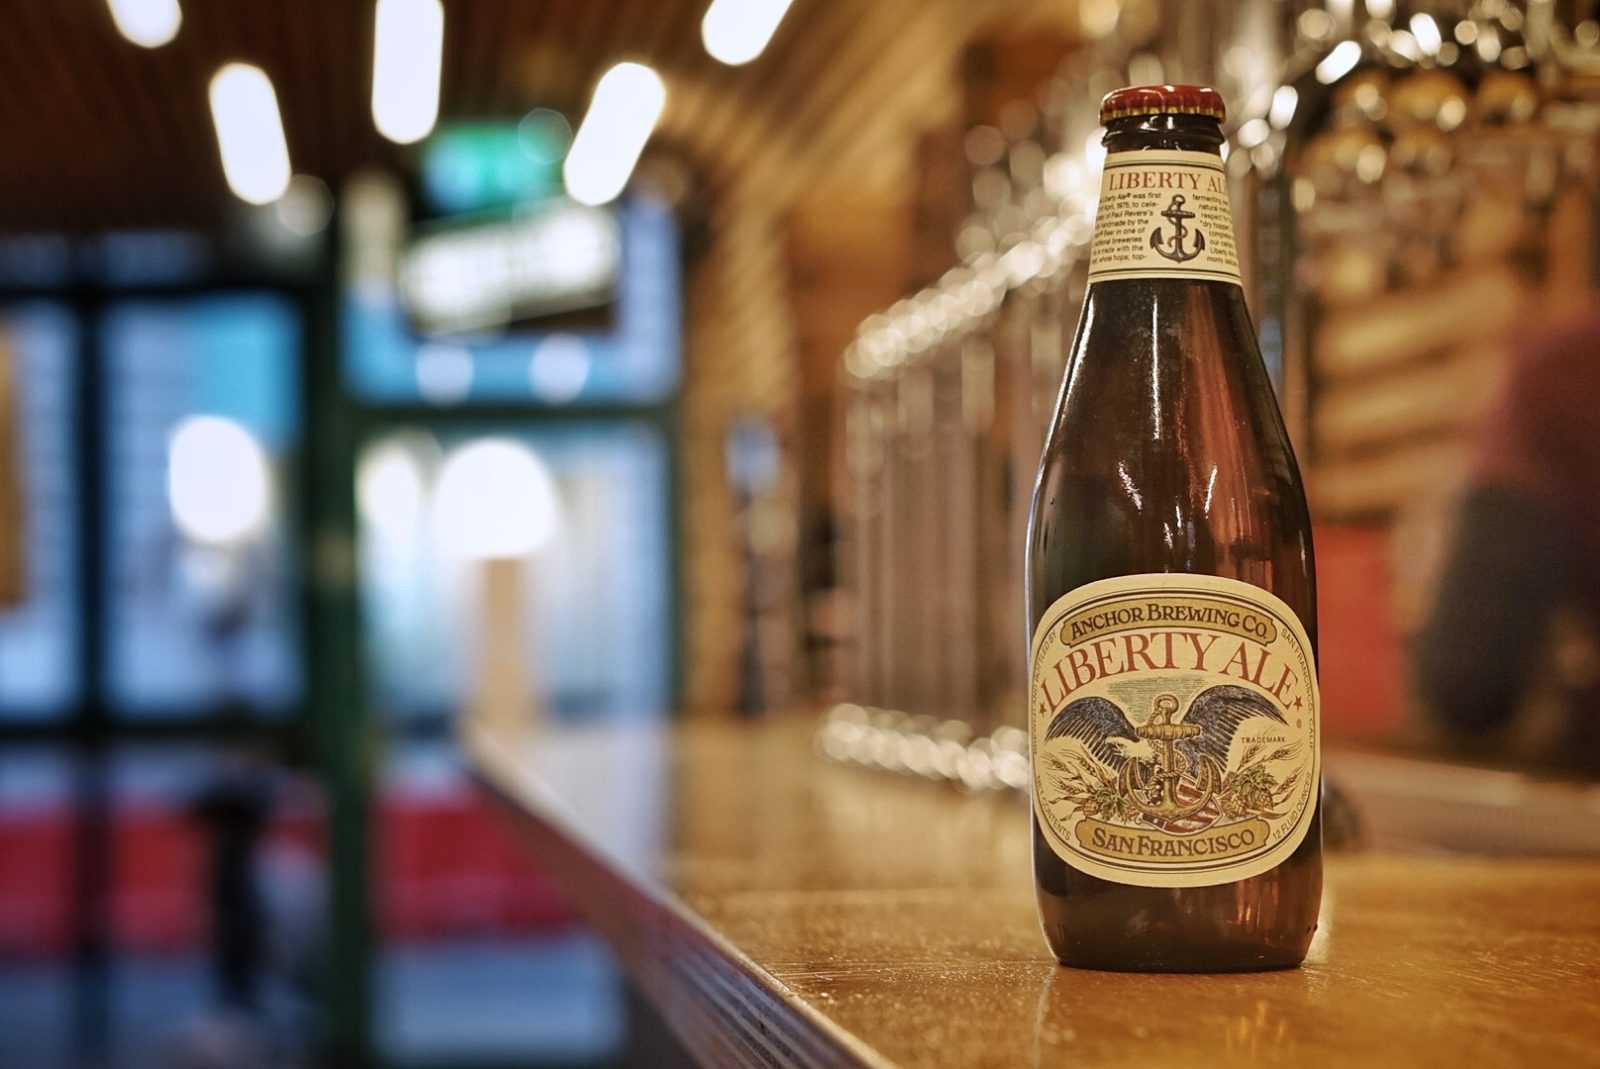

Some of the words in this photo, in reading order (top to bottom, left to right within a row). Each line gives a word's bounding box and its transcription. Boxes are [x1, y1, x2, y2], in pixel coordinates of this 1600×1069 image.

[1109, 172, 1201, 190] LIBERTY
[1127, 219, 1136, 227] by
[1071, 606, 1145, 641] ANCHOR
[1146, 603, 1240, 629] BREWING
[1048, 629, 1057, 642] BY
[1281, 627, 1296, 649] SAN
[1040, 631, 1220, 711] LIBERTY
[1218, 641, 1300, 711] ALE
[1241, 736, 1286, 745] TRADEMARK
[1272, 829, 1282, 841] 12
[1280, 810, 1299, 835] FLUID
[1091, 829, 1136, 852] SAN
[1137, 829, 1255, 857] FRANCISCO
